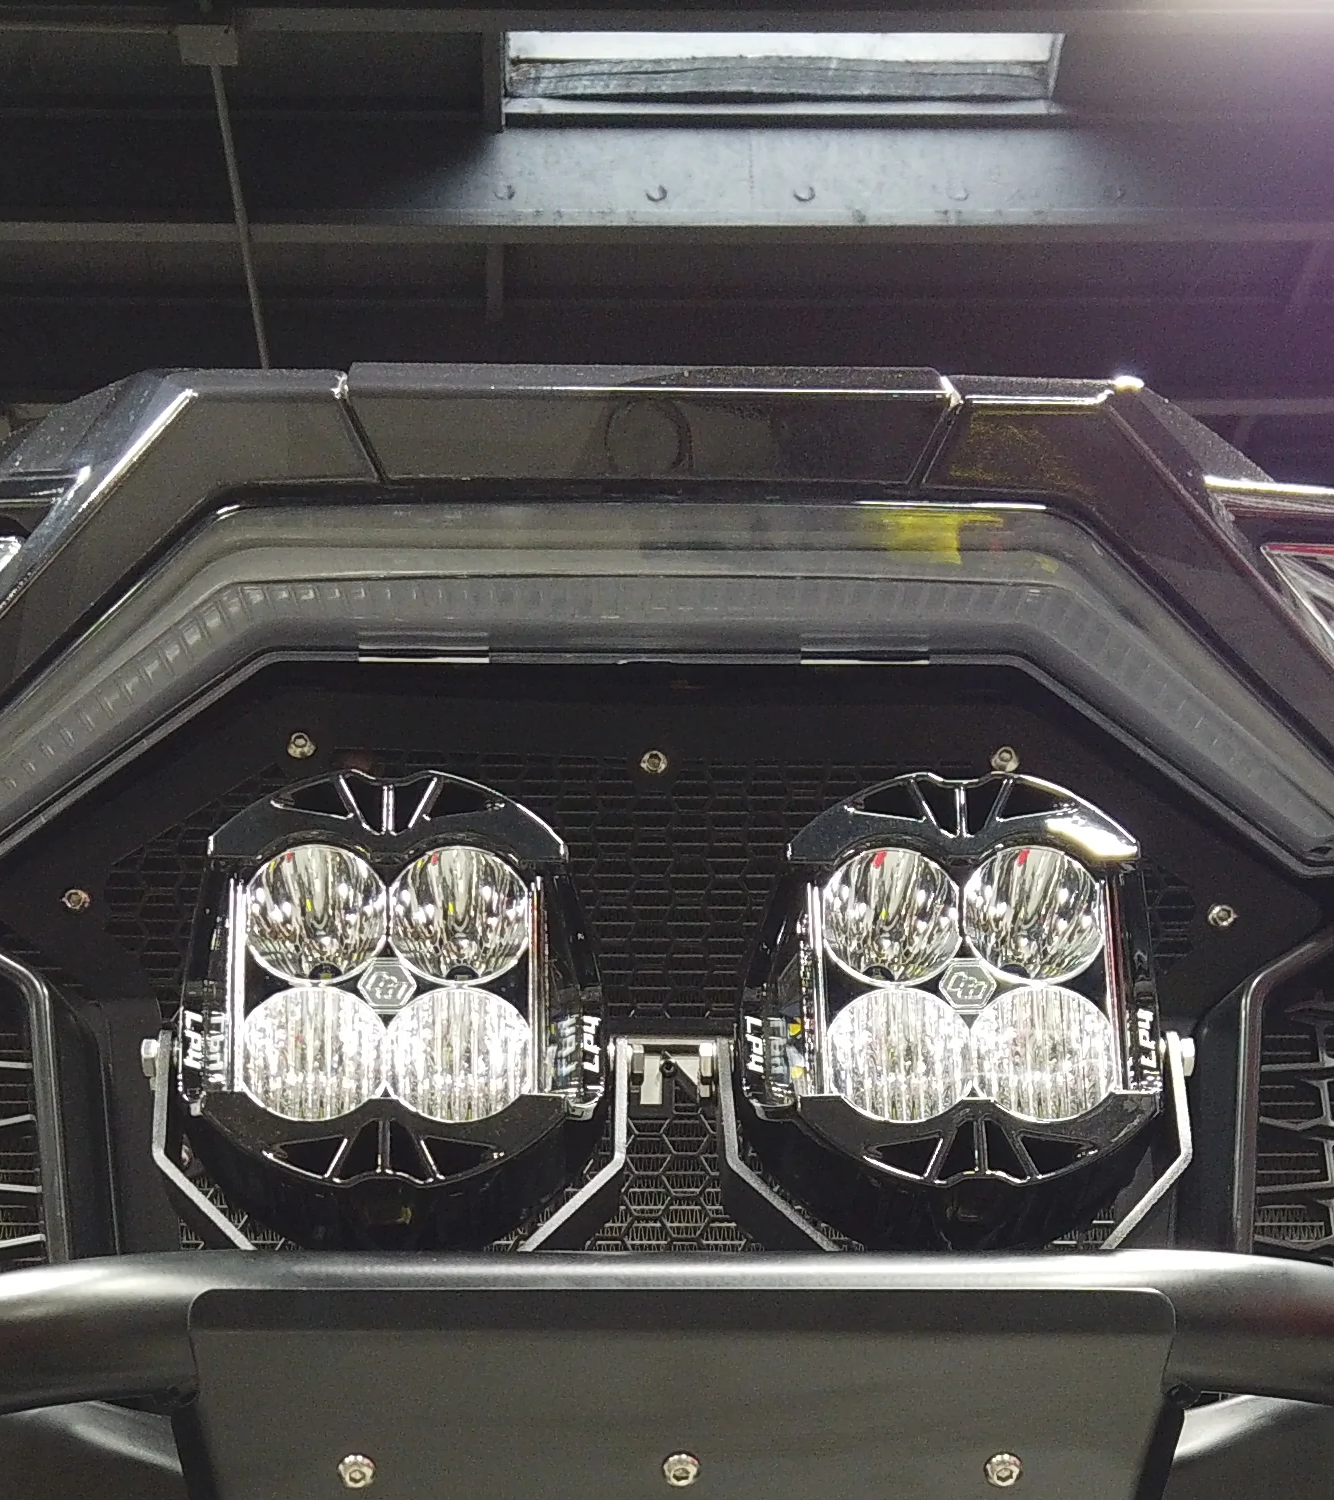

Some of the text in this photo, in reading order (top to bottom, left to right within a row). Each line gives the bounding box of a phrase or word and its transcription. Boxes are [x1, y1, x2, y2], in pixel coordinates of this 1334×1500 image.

[183, 1010, 203, 1070] LP4
[582, 1015, 602, 1074] LP4
[744, 1015, 764, 1073] LP4
